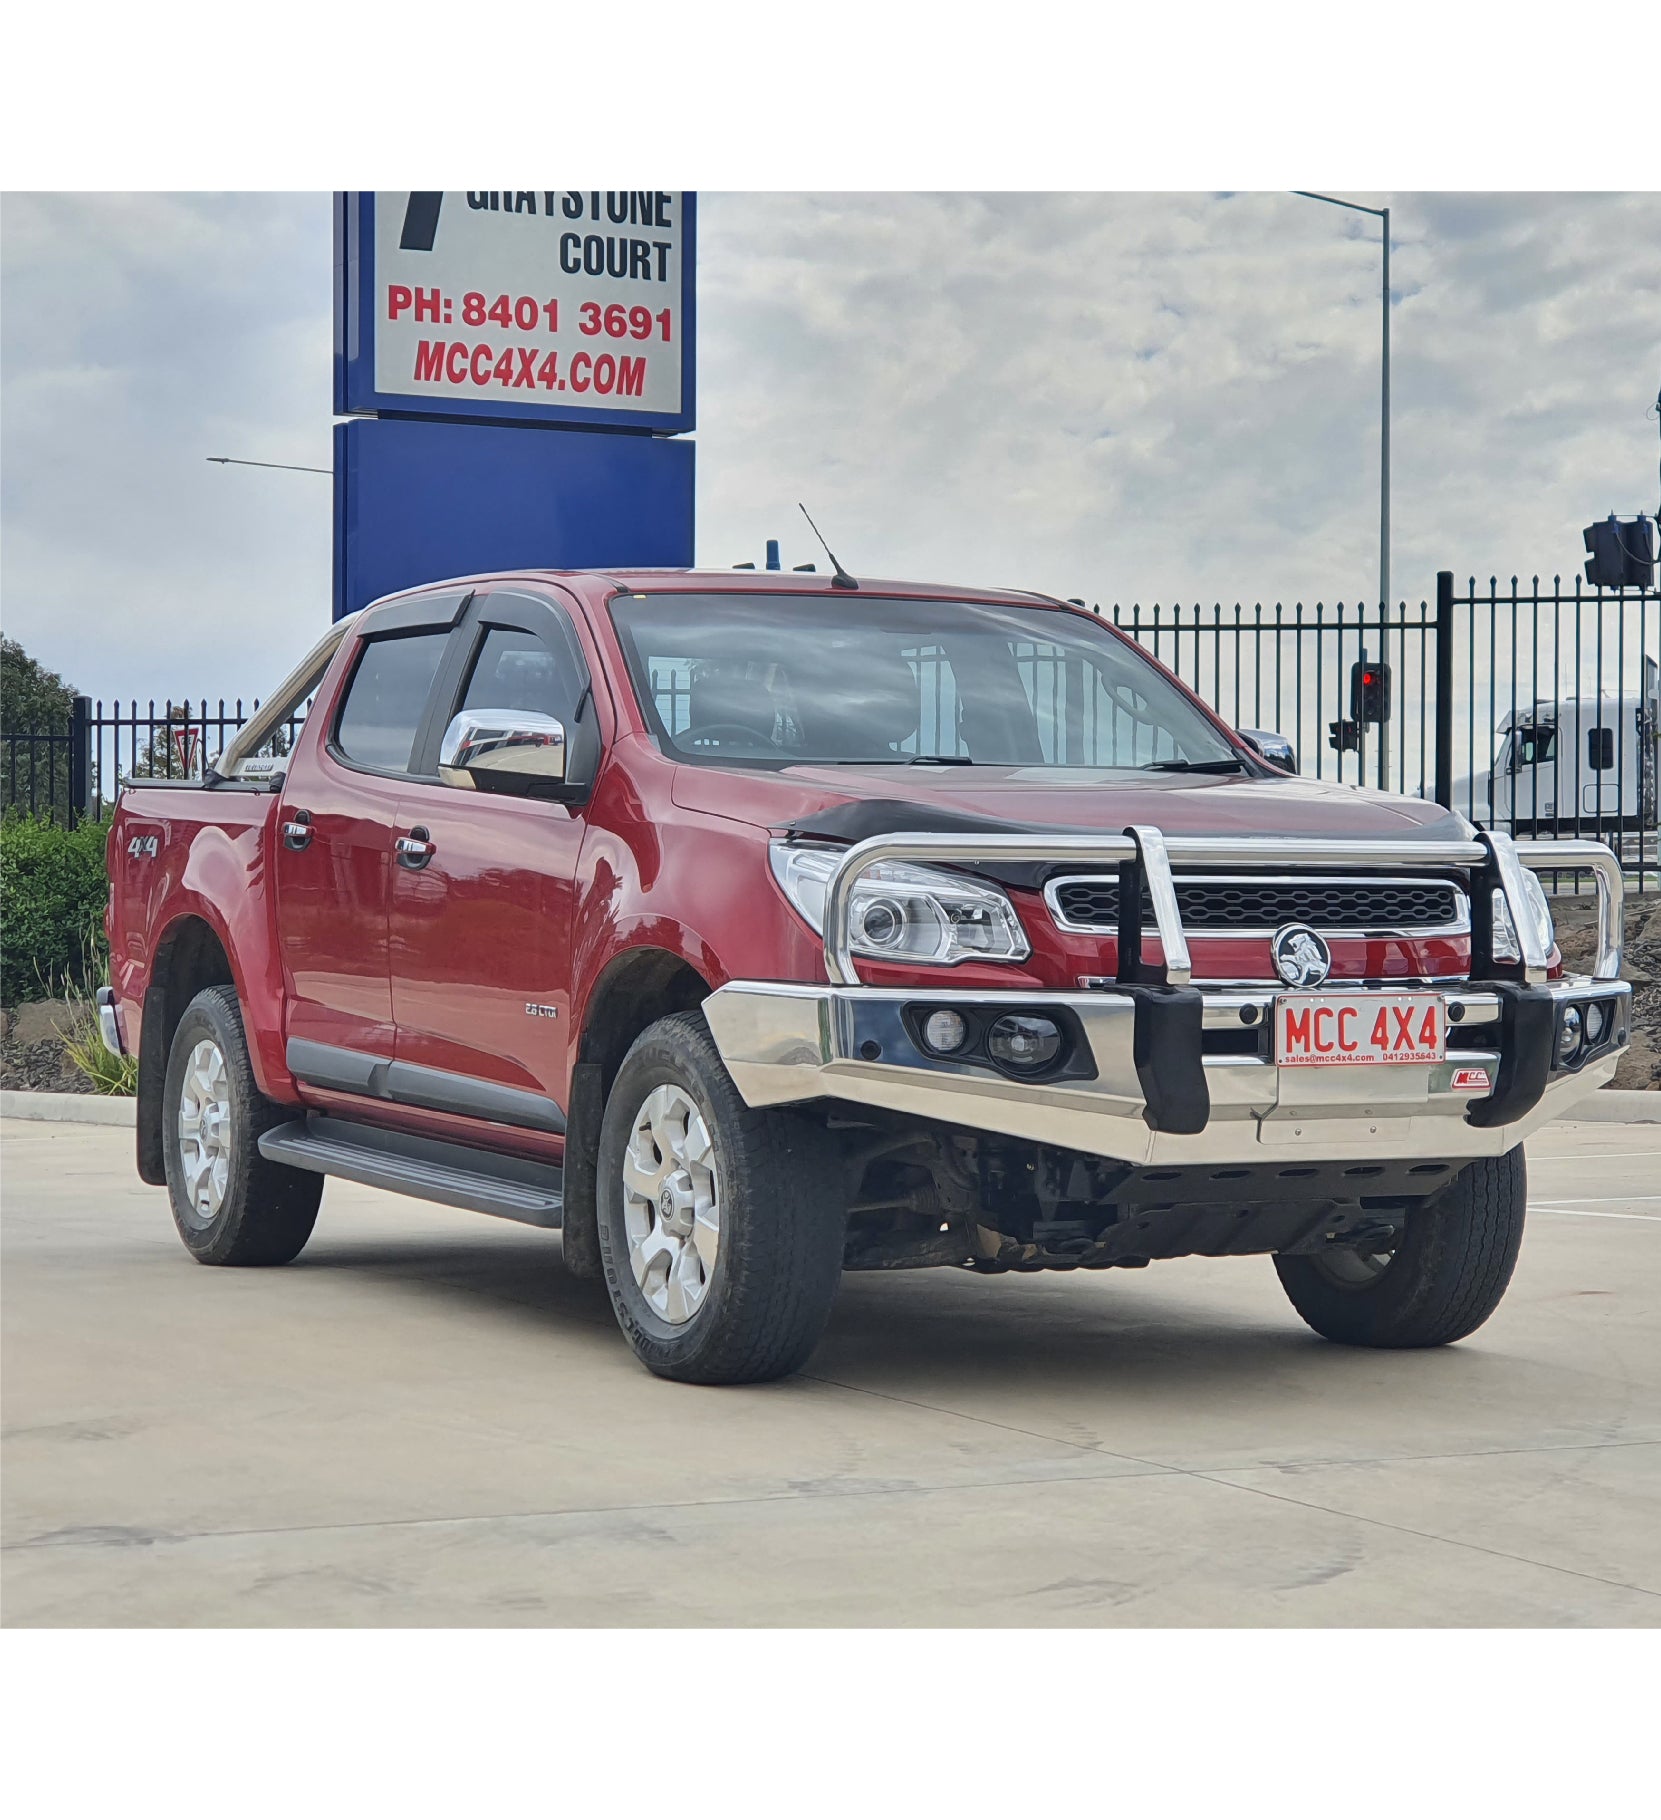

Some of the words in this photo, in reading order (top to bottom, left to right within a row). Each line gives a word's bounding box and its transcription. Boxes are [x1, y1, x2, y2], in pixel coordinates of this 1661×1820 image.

[560, 232, 672, 282] COURT
[388, 285, 452, 324] PH:
[462, 292, 558, 333] 8401
[578, 302, 671, 342] 3691
[414, 340, 646, 397] MCC4X4.COM
[1286, 1007, 1358, 1053] MCC
[1370, 1006, 1437, 1051] 4X4
[1285, 1053, 1375, 1063] sales@mcc4x4.com
